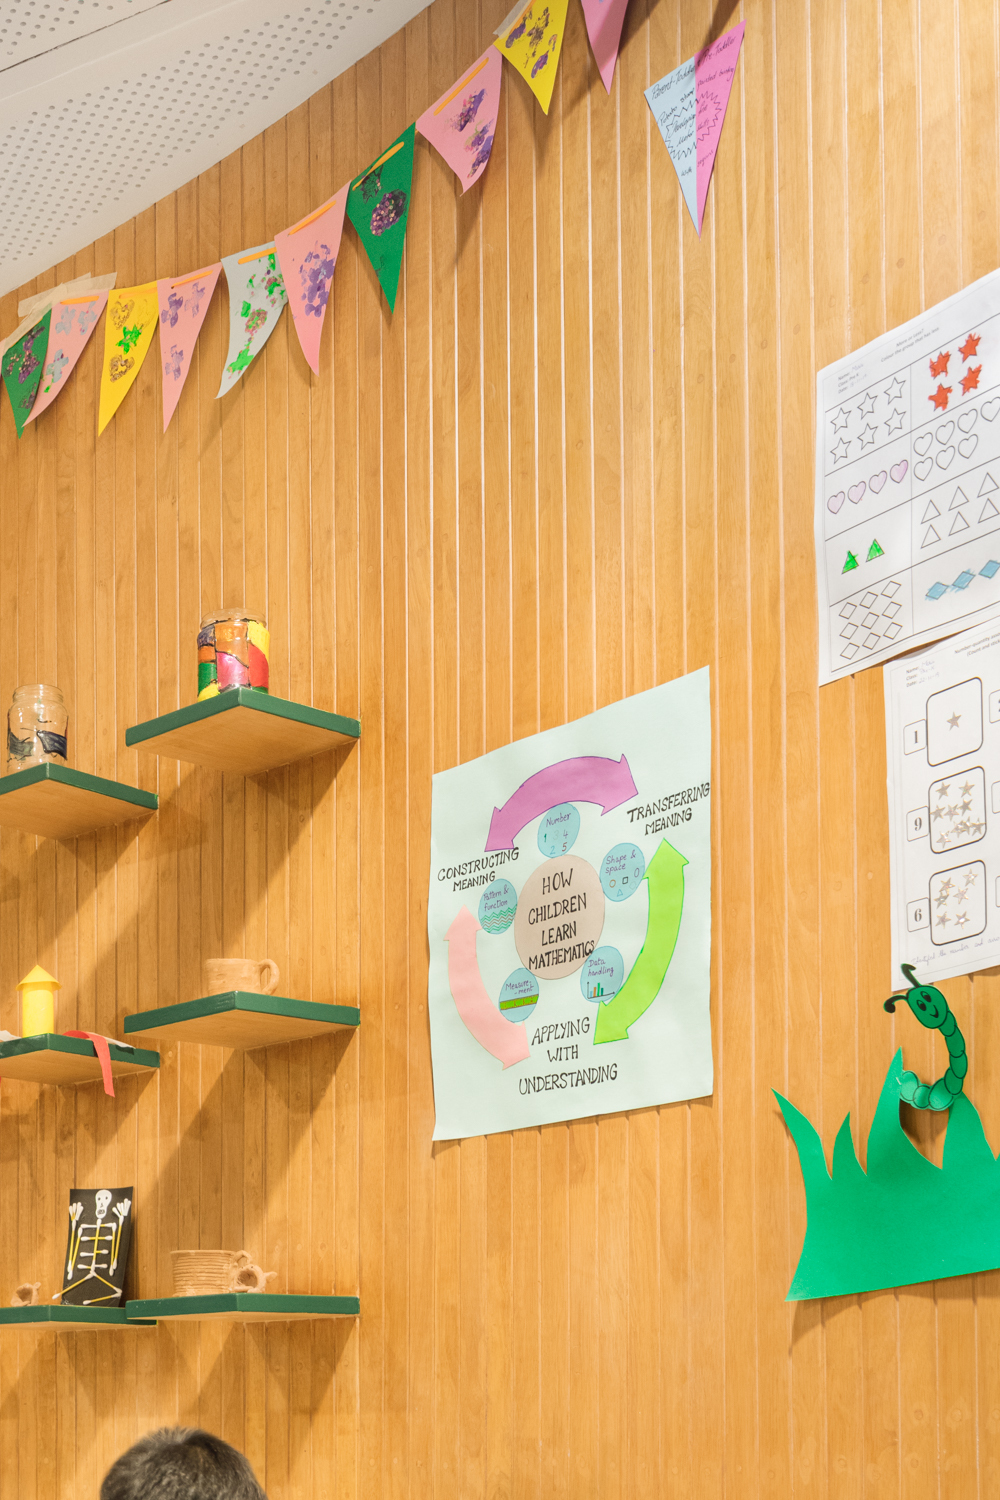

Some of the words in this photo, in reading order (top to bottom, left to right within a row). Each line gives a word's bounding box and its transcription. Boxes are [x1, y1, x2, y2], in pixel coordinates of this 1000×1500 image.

[881, 352, 894, 362] Colour
[912, 730, 920, 745] 1
[627, 782, 710, 823] TRANSFERRING
[546, 812, 571, 828] Number
[644, 807, 693, 836] MEANING
[913, 816, 923, 832] 9
[543, 833, 548, 843] 1
[563, 829, 569, 839] 4
[550, 845, 556, 855] 2
[562, 842, 568, 852] 5
[605, 853, 628, 865] Shape
[630, 849, 637, 859] &
[437, 847, 520, 882] CONSTRUCTING
[453, 870, 496, 892] MEANING
[542, 867, 574, 895] HOW
[483, 890, 502, 901] Pattern
[503, 884, 510, 895] &
[484, 899, 508, 912] function
[528, 892, 587, 925] CHILDREN
[913, 907, 923, 923] 6
[541, 920, 577, 947] LEARN
[528, 940, 595, 970] MATHEMATICS
[587, 957, 606, 967] Data
[587, 965, 615, 977] handling
[531, 1016, 591, 1046] APPLYING
[547, 1044, 579, 1063] WITH
[519, 1063, 618, 1095] UNDERSTANDING
